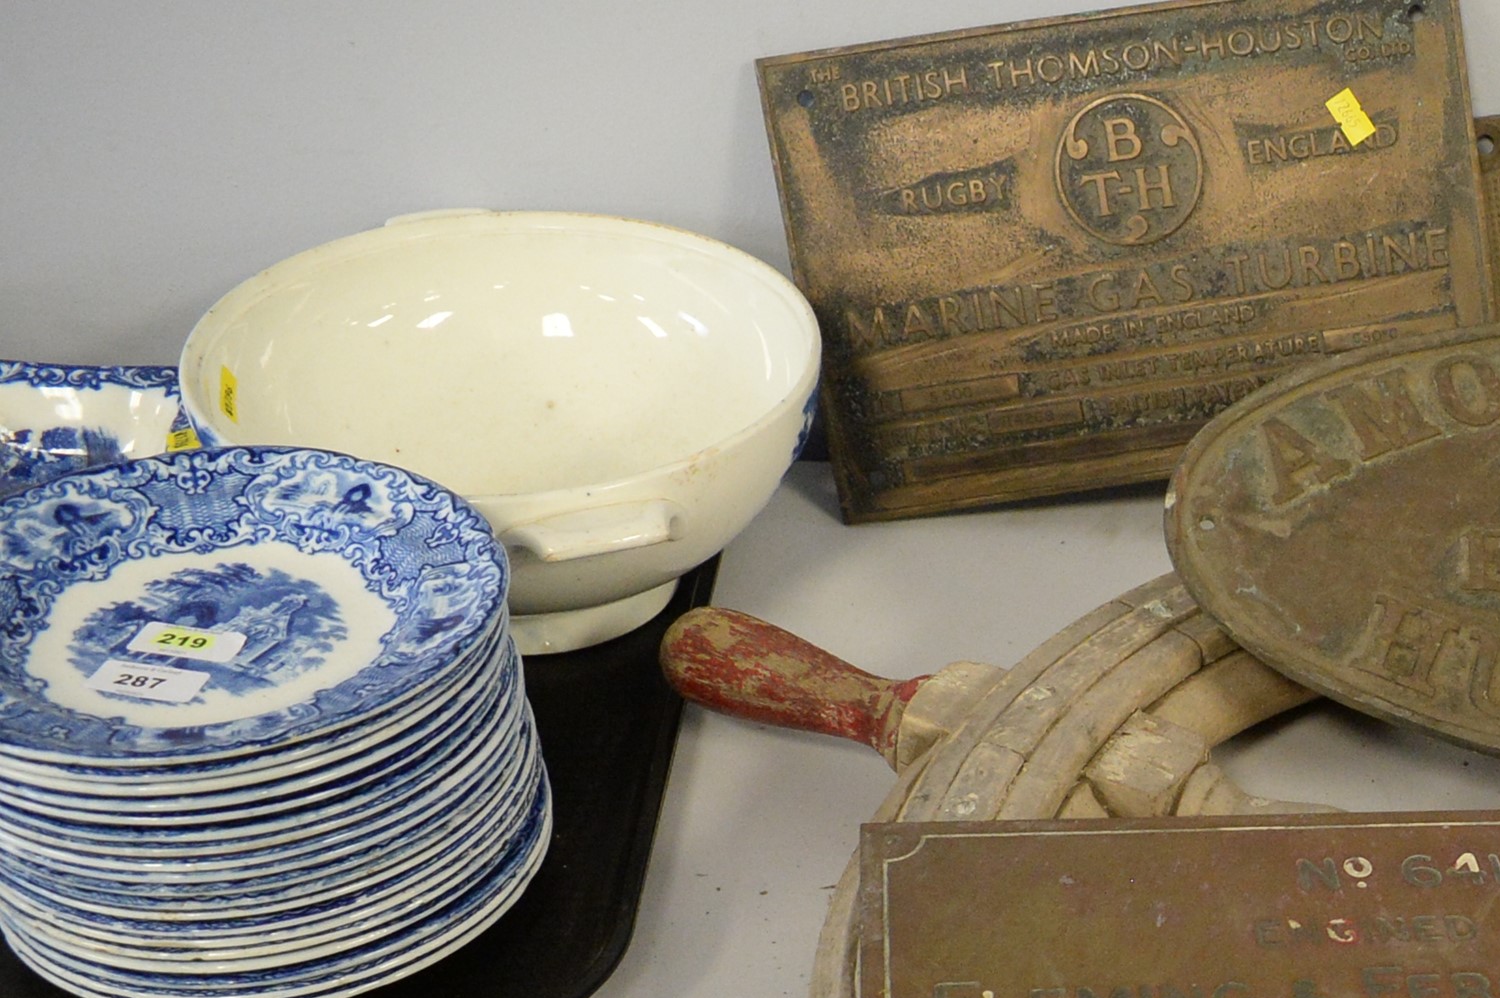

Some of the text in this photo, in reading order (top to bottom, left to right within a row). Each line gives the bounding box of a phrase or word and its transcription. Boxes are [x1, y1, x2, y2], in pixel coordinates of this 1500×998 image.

[809, 14, 1383, 113] THE BRITISH THOMSON-HOUSTON
[1104, 117, 1143, 163] B
[902, 174, 1008, 213] RUGBY
[846, 228, 1451, 349] MARINE GAS TURBINE
[1051, 304, 1256, 349] MADE IN ENGLAND
[1047, 366, 1090, 392] GAS
[1168, 335, 1321, 374] TEMPERATURE
[157, 633, 208, 649] 219
[113, 673, 167, 689] 287
